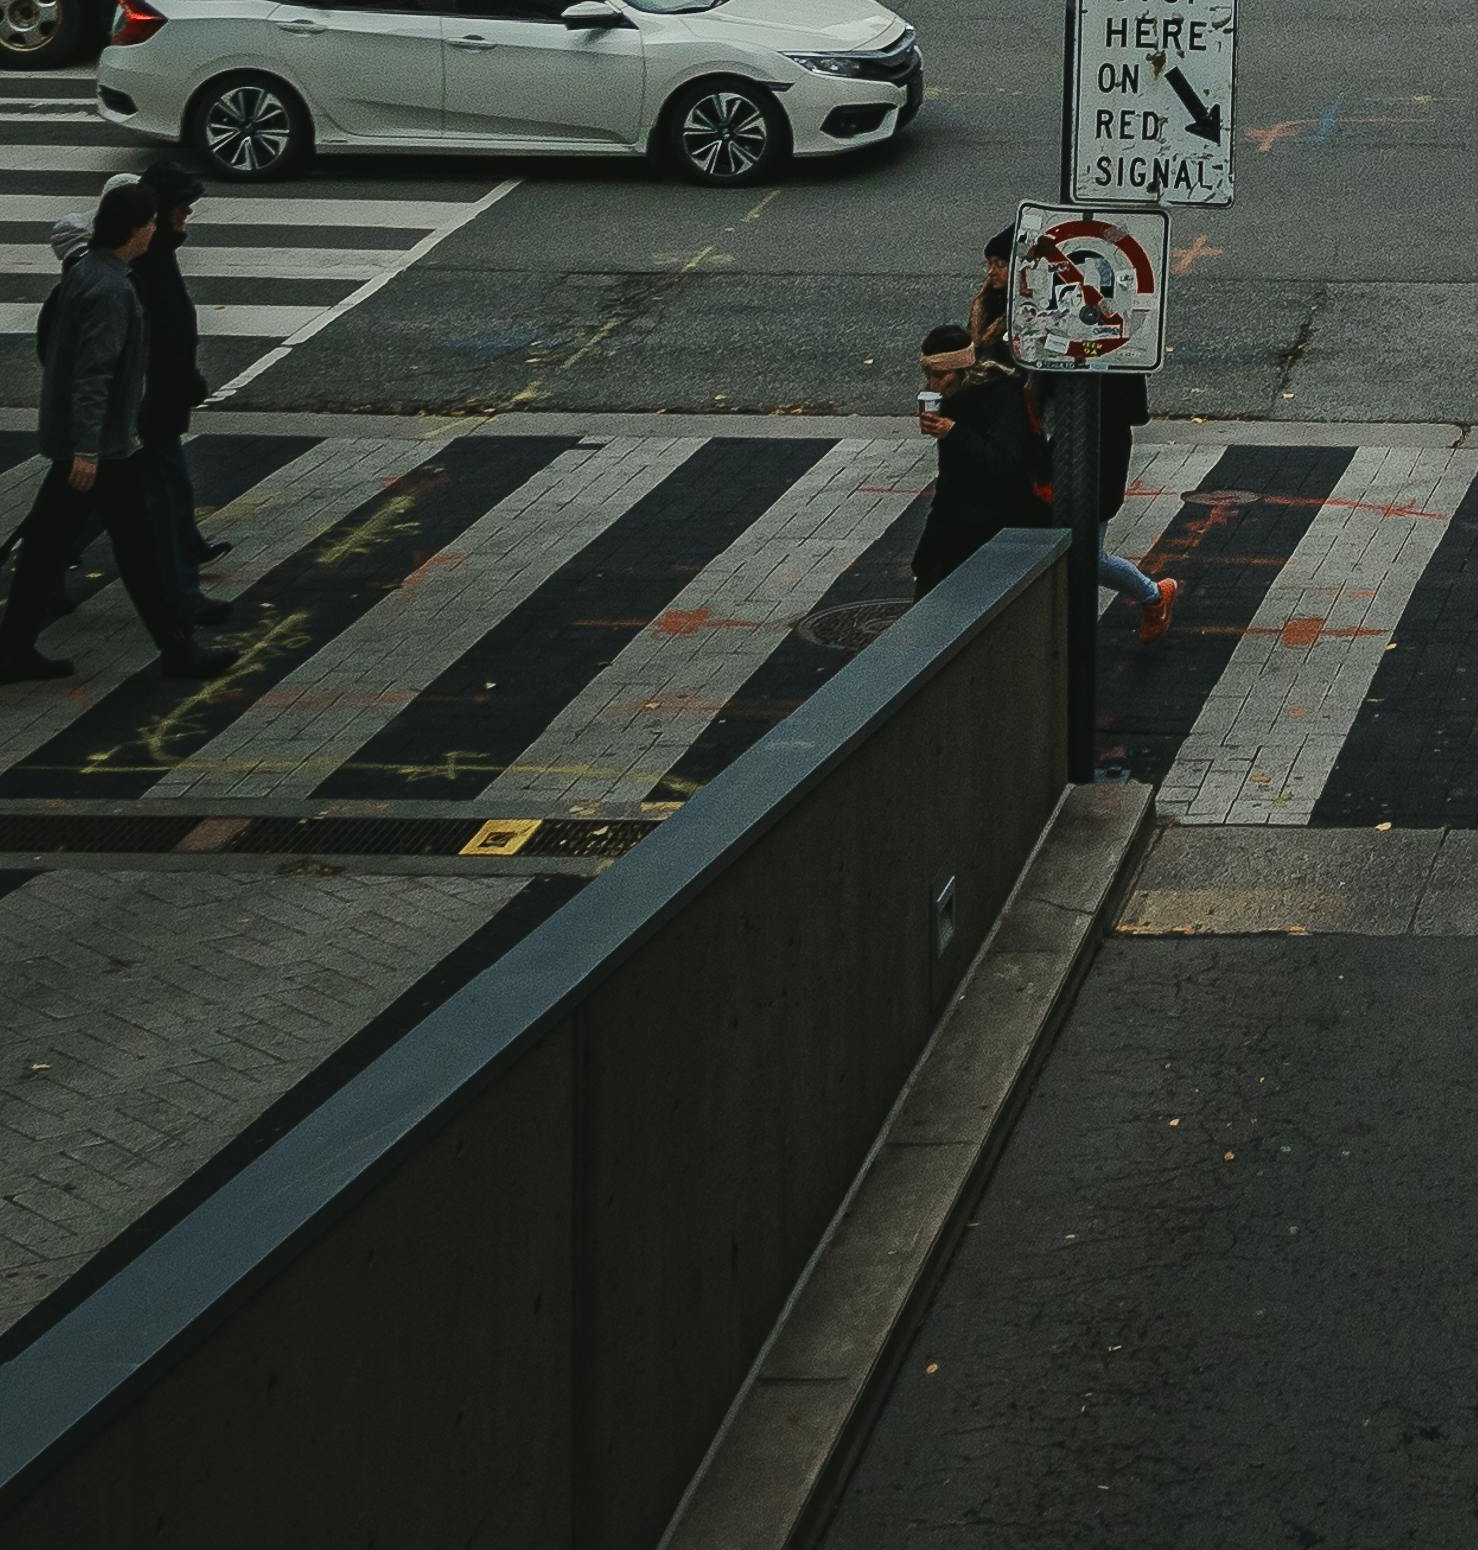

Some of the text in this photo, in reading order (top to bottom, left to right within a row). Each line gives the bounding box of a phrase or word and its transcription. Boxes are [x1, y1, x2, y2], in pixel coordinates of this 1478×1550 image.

[1105, 17, 1207, 51] HERE
[1098, 63, 1139, 94] ON
[1096, 109, 1160, 140] RED
[1095, 156, 1213, 190] SIGNAL
